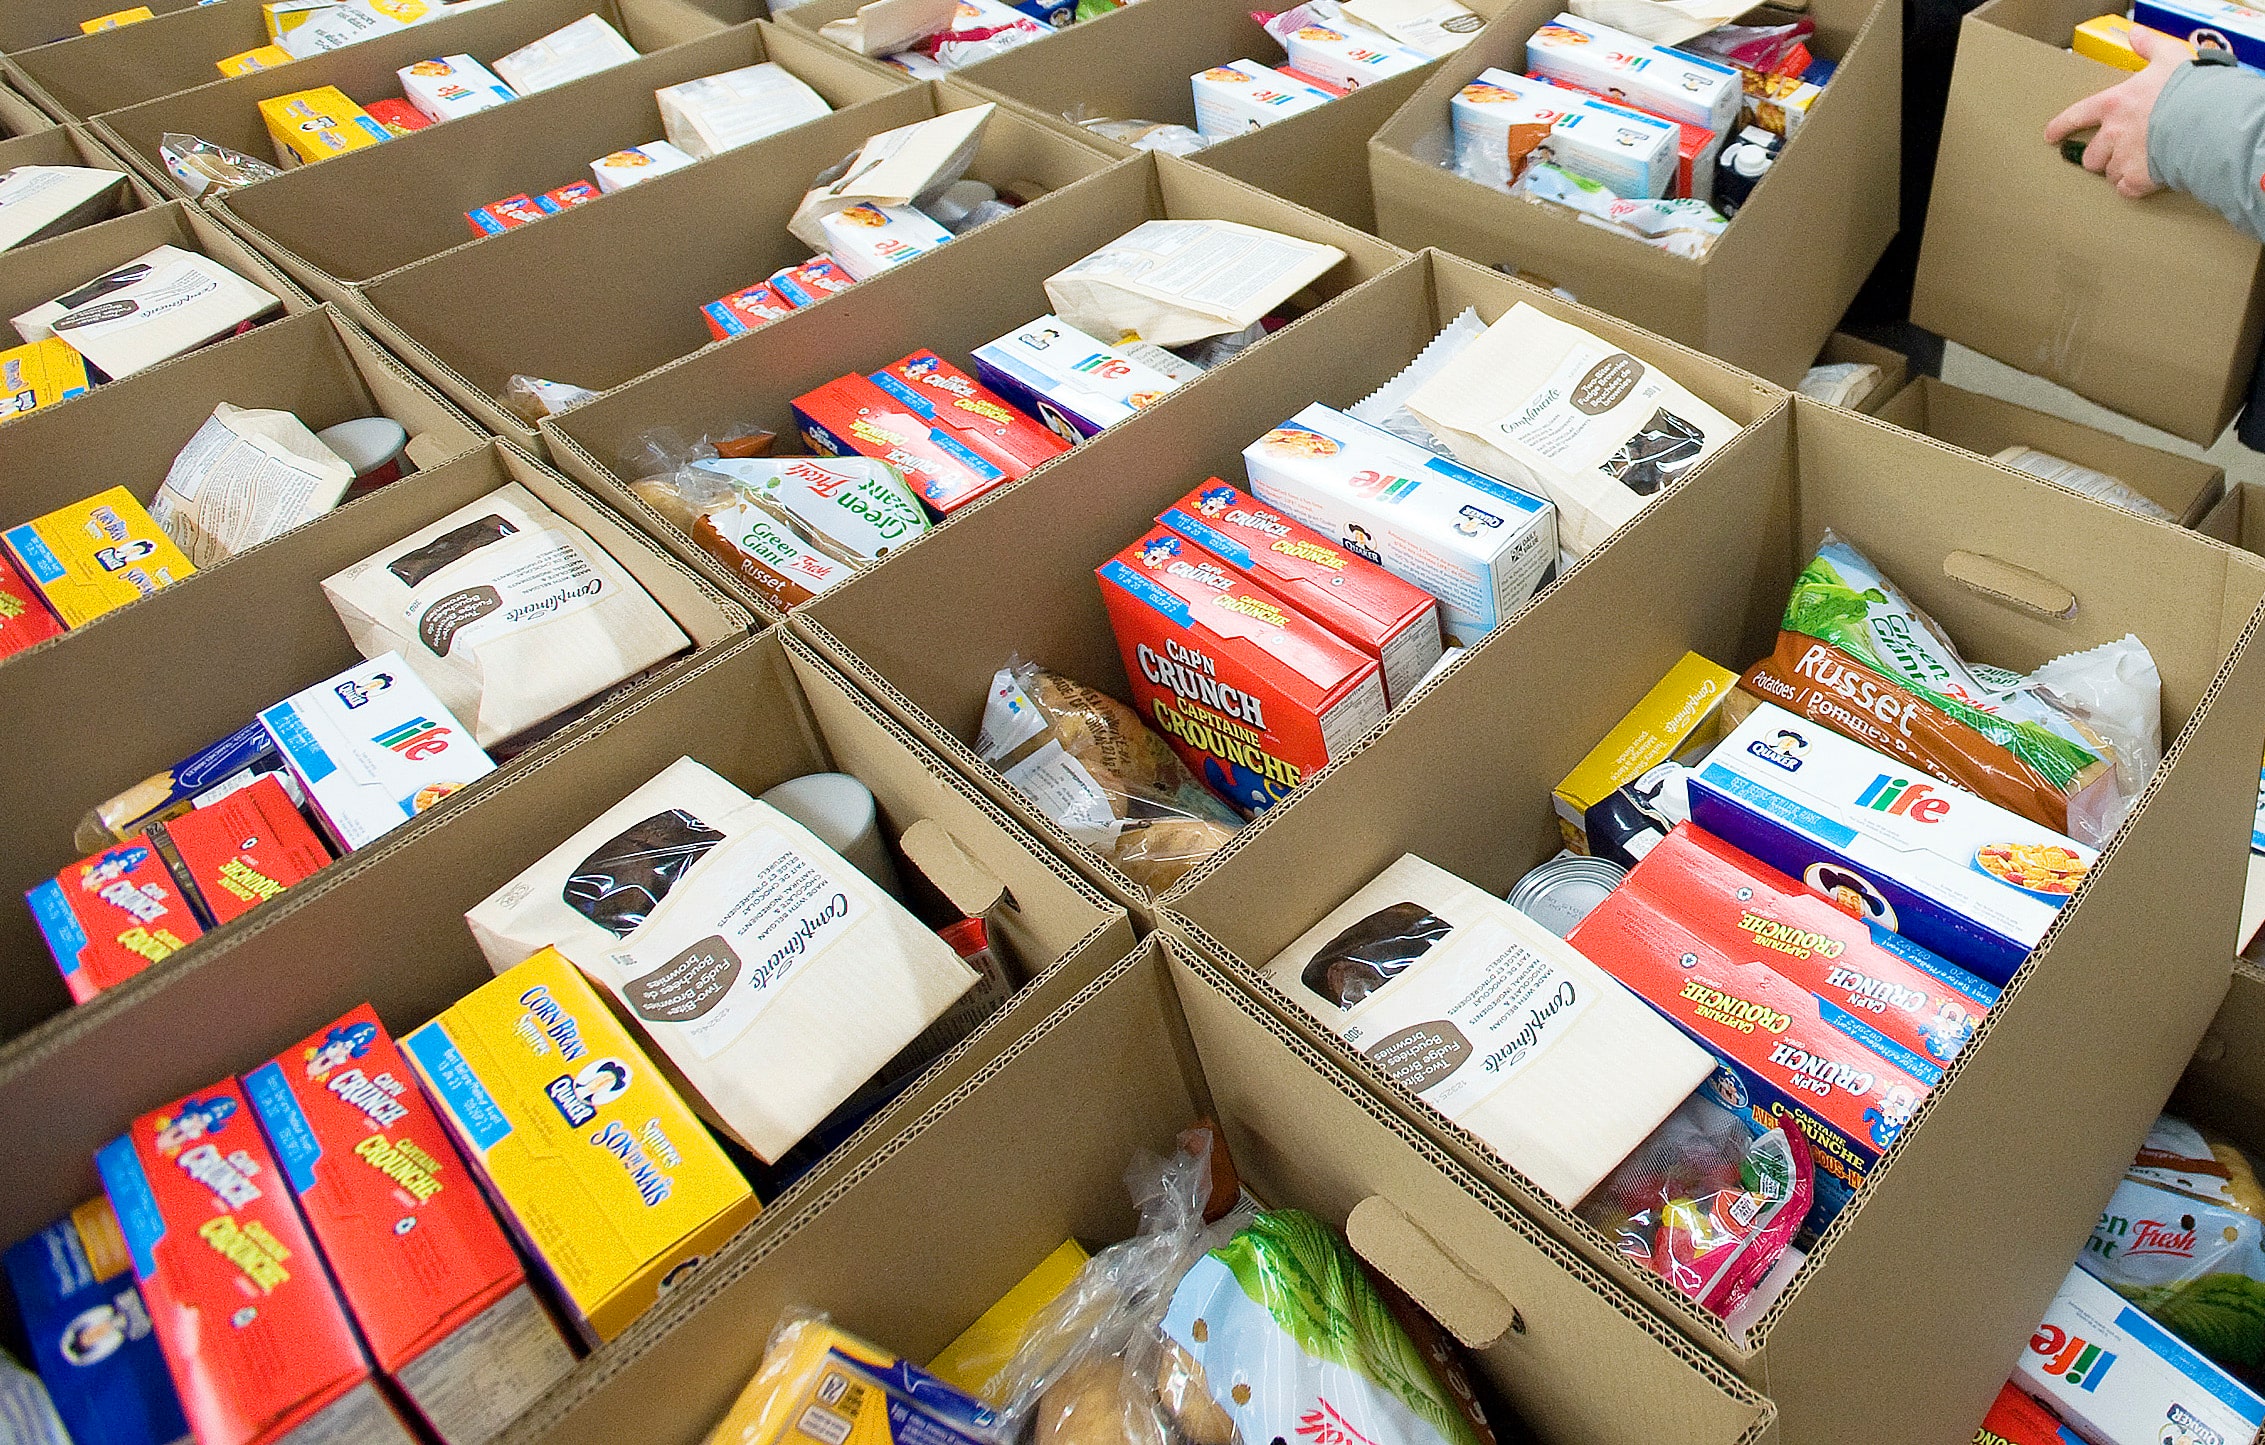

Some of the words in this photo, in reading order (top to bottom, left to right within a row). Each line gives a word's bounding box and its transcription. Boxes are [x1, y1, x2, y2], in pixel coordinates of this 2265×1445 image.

[1072, 353, 1130, 378] life
[1578, 384, 1600, 406] Fudge
[1598, 358, 1627, 386] Brownies
[1501, 387, 1563, 434] Compliments
[786, 462, 849, 497] Fresh
[859, 479, 921, 525] Giant
[1350, 471, 1421, 503] life
[838, 493, 903, 539] Green
[1224, 510, 1292, 537] CRUNCH
[742, 535, 784, 566] Giant
[753, 523, 797, 557] Green
[741, 559, 786, 591] Russet
[1166, 561, 1236, 591] CRUNCH
[503, 578, 602, 623] Compliments
[1166, 638, 1214, 675] CAP'N
[1871, 616, 1927, 684] Giant
[1887, 613, 1951, 680] Green
[1138, 643, 1264, 729] CRUNCH
[1751, 670, 1796, 701] Potatoes
[1795, 642, 1919, 739] Russet
[372, 717, 451, 761] life
[1177, 697, 1260, 746] CAPITAINE
[1153, 701, 1301, 788] CROUNCHE
[1752, 742, 1799, 770] QUAKER
[1855, 774, 1949, 823] life
[748, 892, 850, 991] Compliments
[1739, 913, 1846, 958] CROUNCHE
[1754, 936, 1810, 960] CAPITAINE
[646, 953, 699, 991] brownies
[659, 953, 715, 998] Bouchées
[693, 957, 731, 990] Fudge
[1827, 968, 1928, 1014] CRUNCH
[641, 985, 696, 1013] Brownies
[1681, 982, 1792, 1035] CROUNCHE
[1696, 1006, 1755, 1033] CAPITAINE
[1848, 991, 1886, 1013] CAP'N
[519, 985, 562, 1029] CORN
[549, 1015, 589, 1062] BRAN
[1342, 1025, 1363, 1043] 300
[1371, 1029, 1425, 1063] brownies
[1481, 980, 1577, 1073] Compliments
[1386, 1033, 1443, 1068] Bouchées
[1419, 1040, 1460, 1065] Fudge
[1770, 1046, 1875, 1097] CRUNCH
[327, 1069, 407, 1127] CRUNCH
[549, 1081, 595, 1126] QUAKER
[1790, 1073, 1831, 1097] CAP'N
[1771, 1101, 1866, 1170] COUNCHE
[1794, 1108, 1847, 1147] CAPITAINE
[355, 1134, 443, 1200] CROUNCHE
[590, 1120, 630, 1161] SON
[635, 1163, 673, 1208] MAÏS
[2132, 1219, 2197, 1249] Fresh
[2031, 1325, 2116, 1393] life
